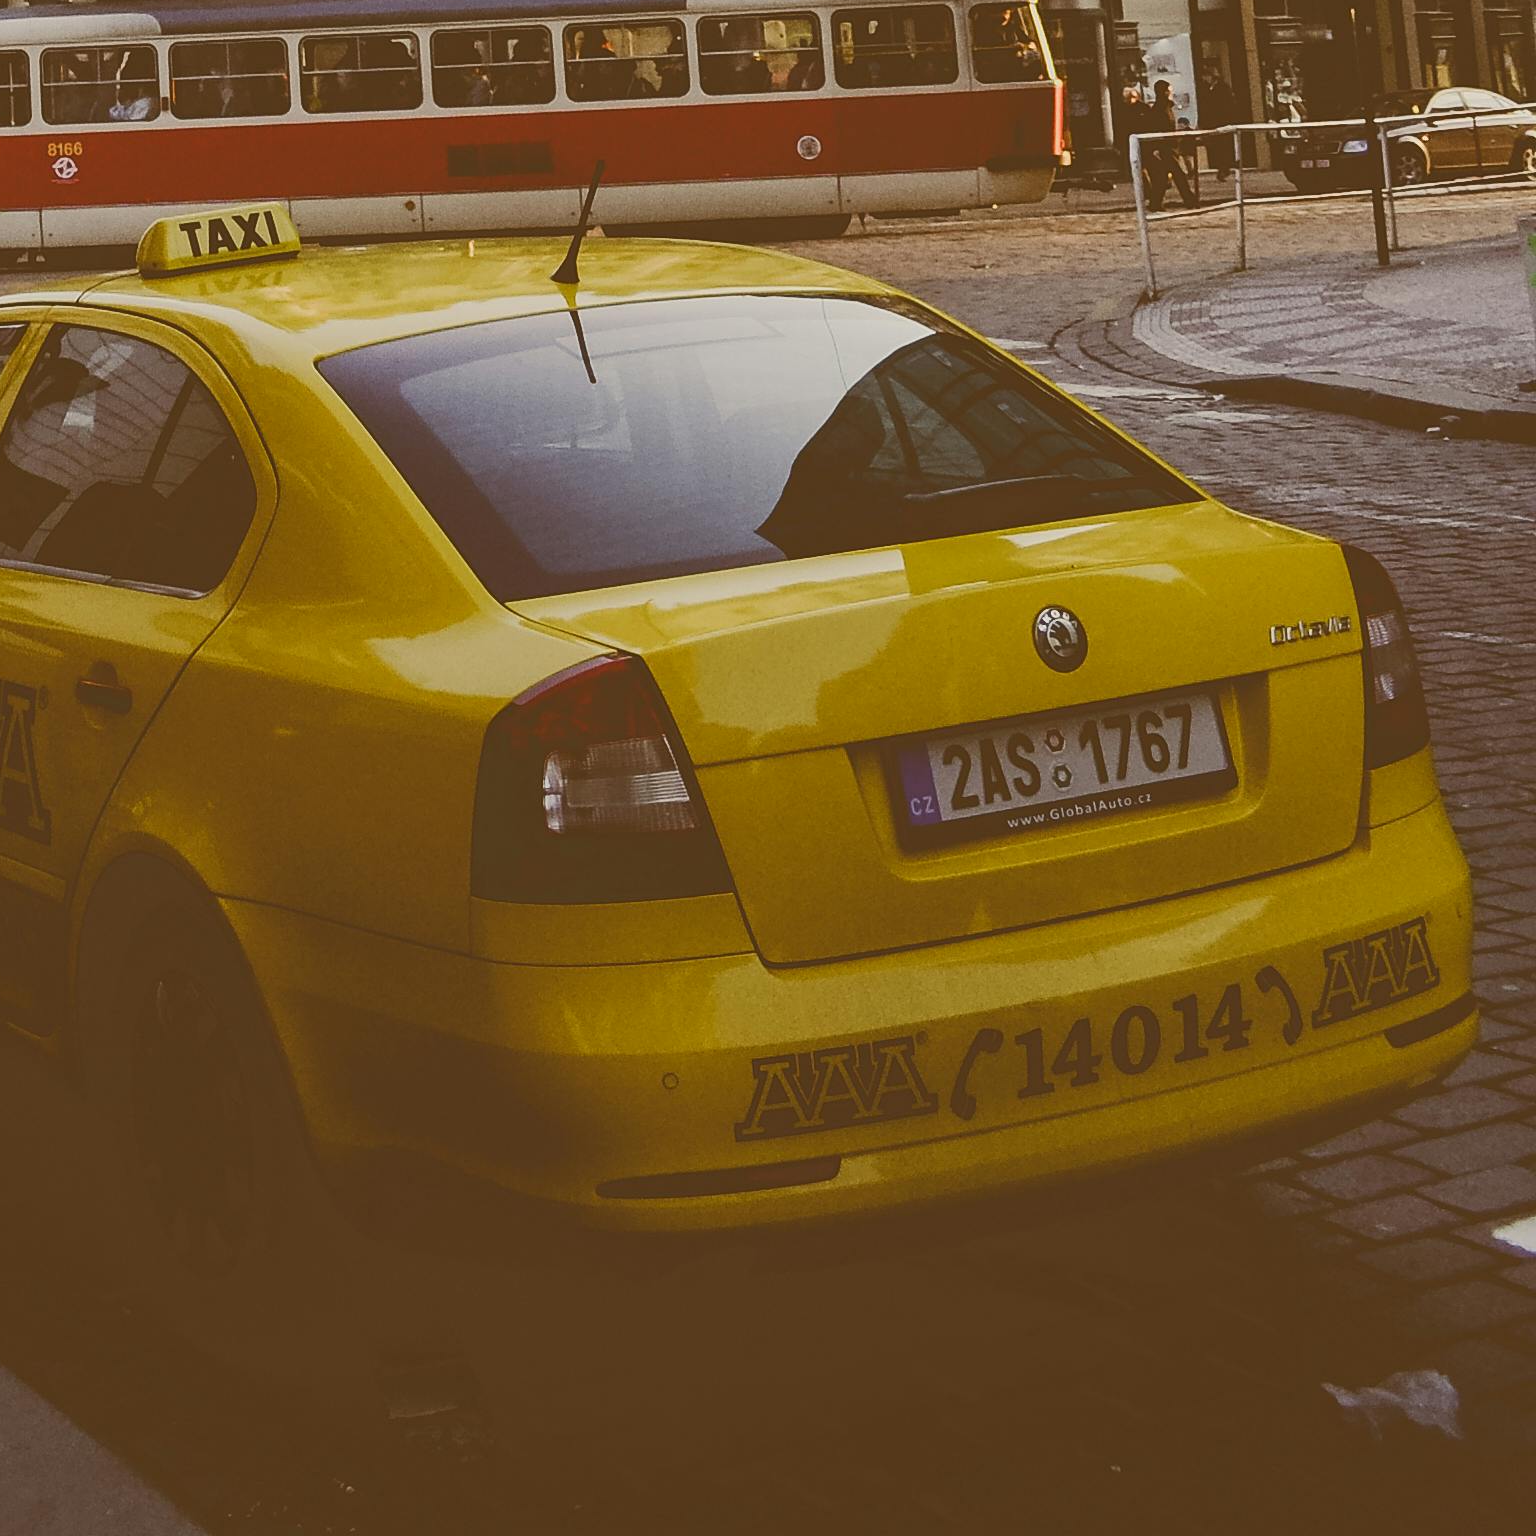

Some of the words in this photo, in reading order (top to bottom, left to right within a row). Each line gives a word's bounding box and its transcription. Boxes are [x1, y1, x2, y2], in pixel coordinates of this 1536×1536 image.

[47, 141, 83, 157] 8166
[178, 210, 281, 258] TAXI
[909, 796, 935, 816] CZ
[941, 731, 1042, 811] 2AS
[1078, 702, 1193, 785] 1767
[1006, 791, 1154, 830] www.GlobalAuto.cz
[735, 1034, 939, 1142] AAA
[1311, 917, 1441, 1029] AAA
